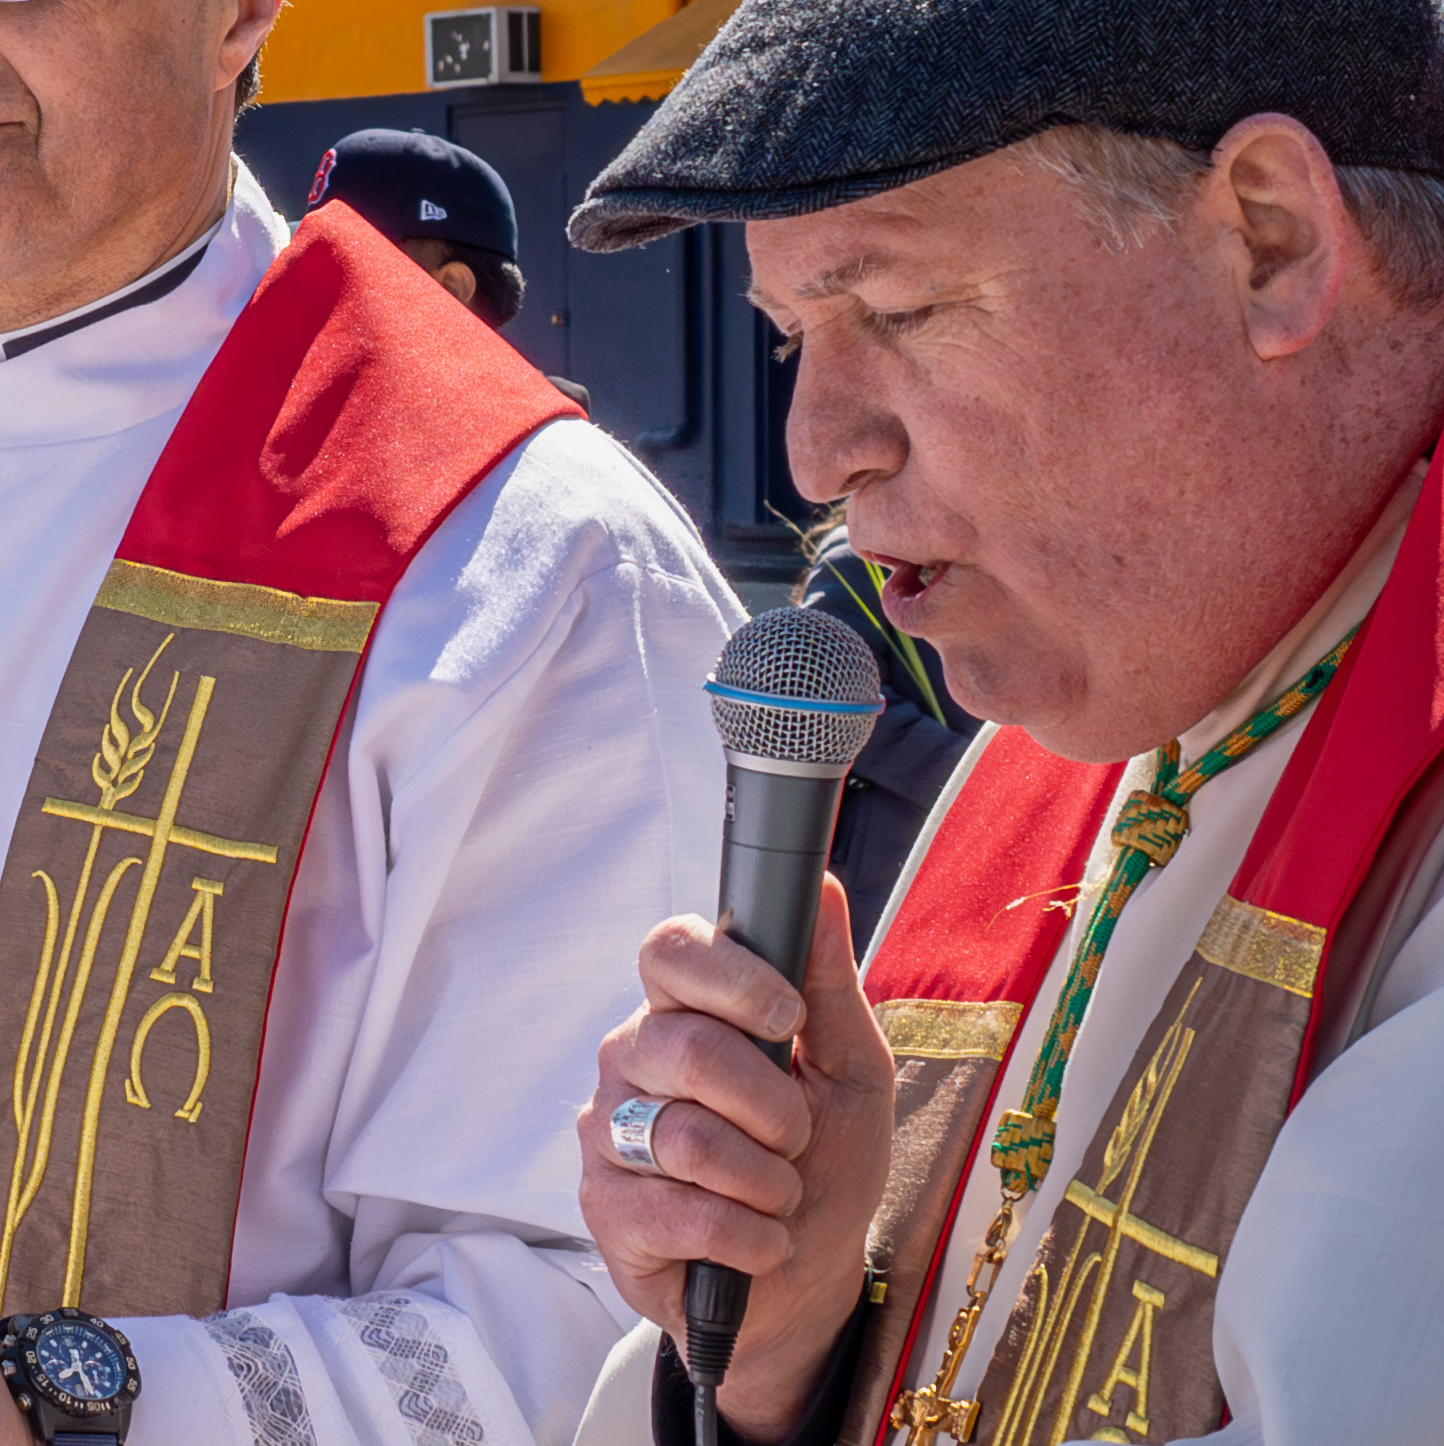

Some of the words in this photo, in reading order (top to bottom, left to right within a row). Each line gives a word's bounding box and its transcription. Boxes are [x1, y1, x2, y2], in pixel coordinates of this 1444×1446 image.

[40, 1314, 55, 1325] 30
[89, 1317, 104, 1329] 40
[26, 1326, 38, 1341] 25
